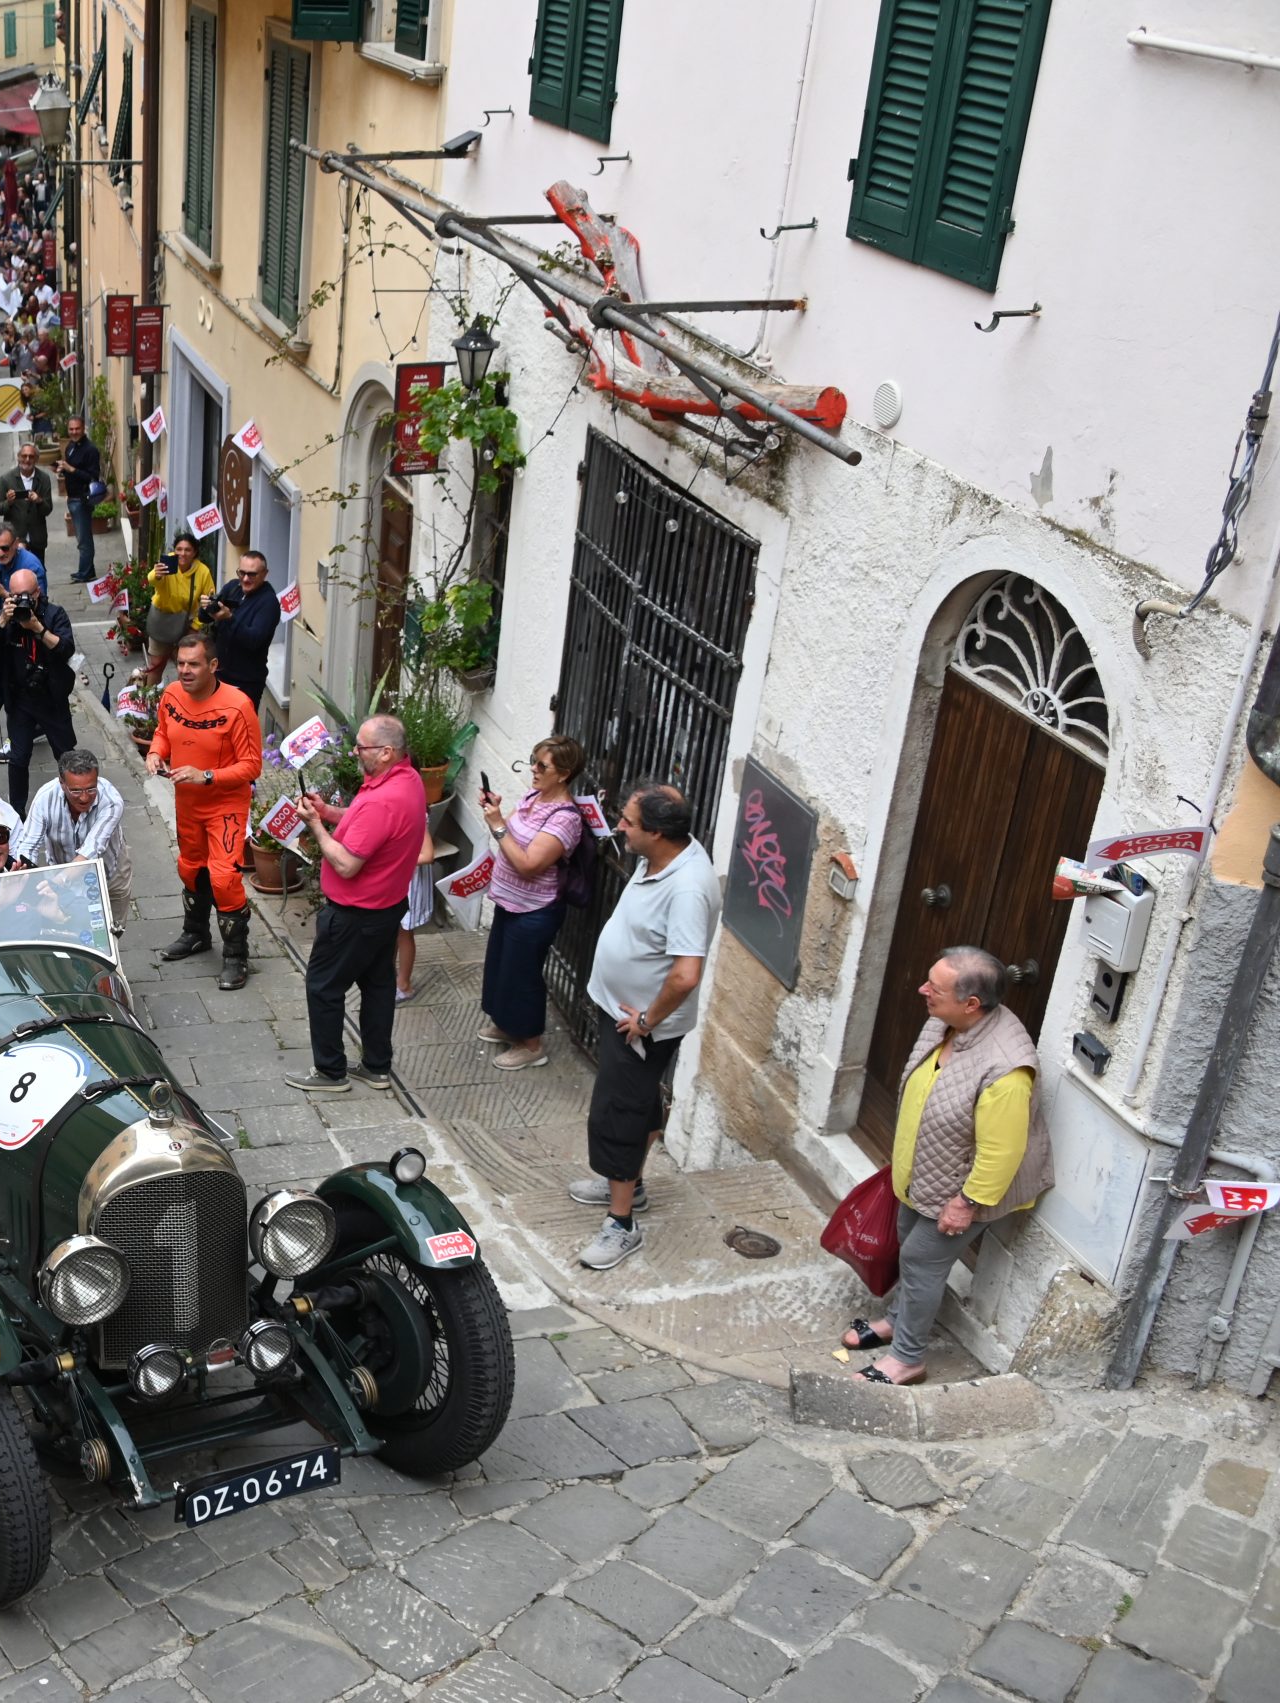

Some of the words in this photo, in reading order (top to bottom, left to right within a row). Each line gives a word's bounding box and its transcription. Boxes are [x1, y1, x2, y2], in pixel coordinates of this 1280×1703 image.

[199, 510, 215, 523] 1000
[165, 703, 228, 730] alpinestars
[271, 807, 290, 828] 1000
[1120, 840, 1196, 857] MIGLIA
[1125, 833, 1193, 847] 1000
[459, 862, 490, 887] 1000
[10, 1072, 36, 1103] 8
[434, 1235, 463, 1247] 1000
[437, 1244, 470, 1258] MIGLIA
